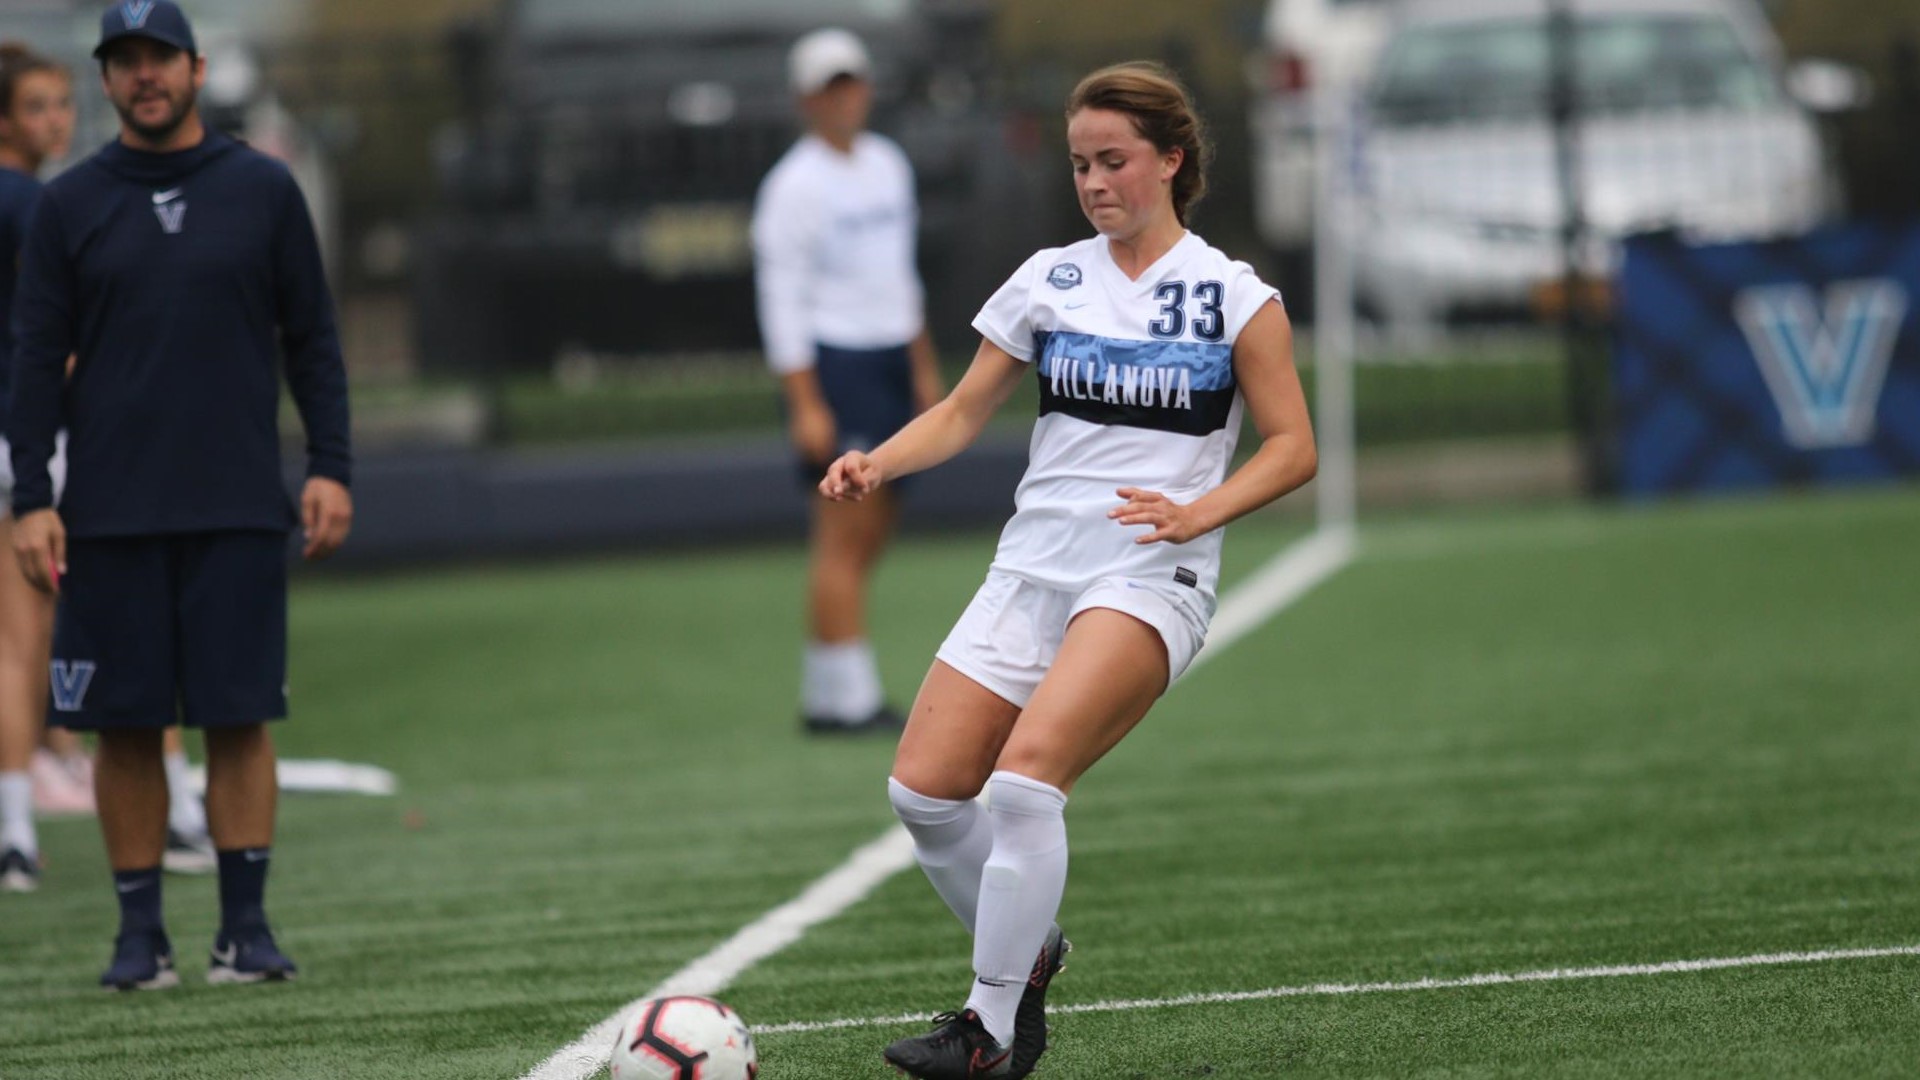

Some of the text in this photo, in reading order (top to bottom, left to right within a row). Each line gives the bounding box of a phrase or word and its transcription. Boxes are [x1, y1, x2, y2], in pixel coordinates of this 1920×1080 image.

[153, 200, 187, 234] V
[1148, 280, 1225, 343] 33
[1051, 357, 1192, 410] VILLANOVA
[1732, 277, 1907, 449] V
[49, 659, 96, 711] V
